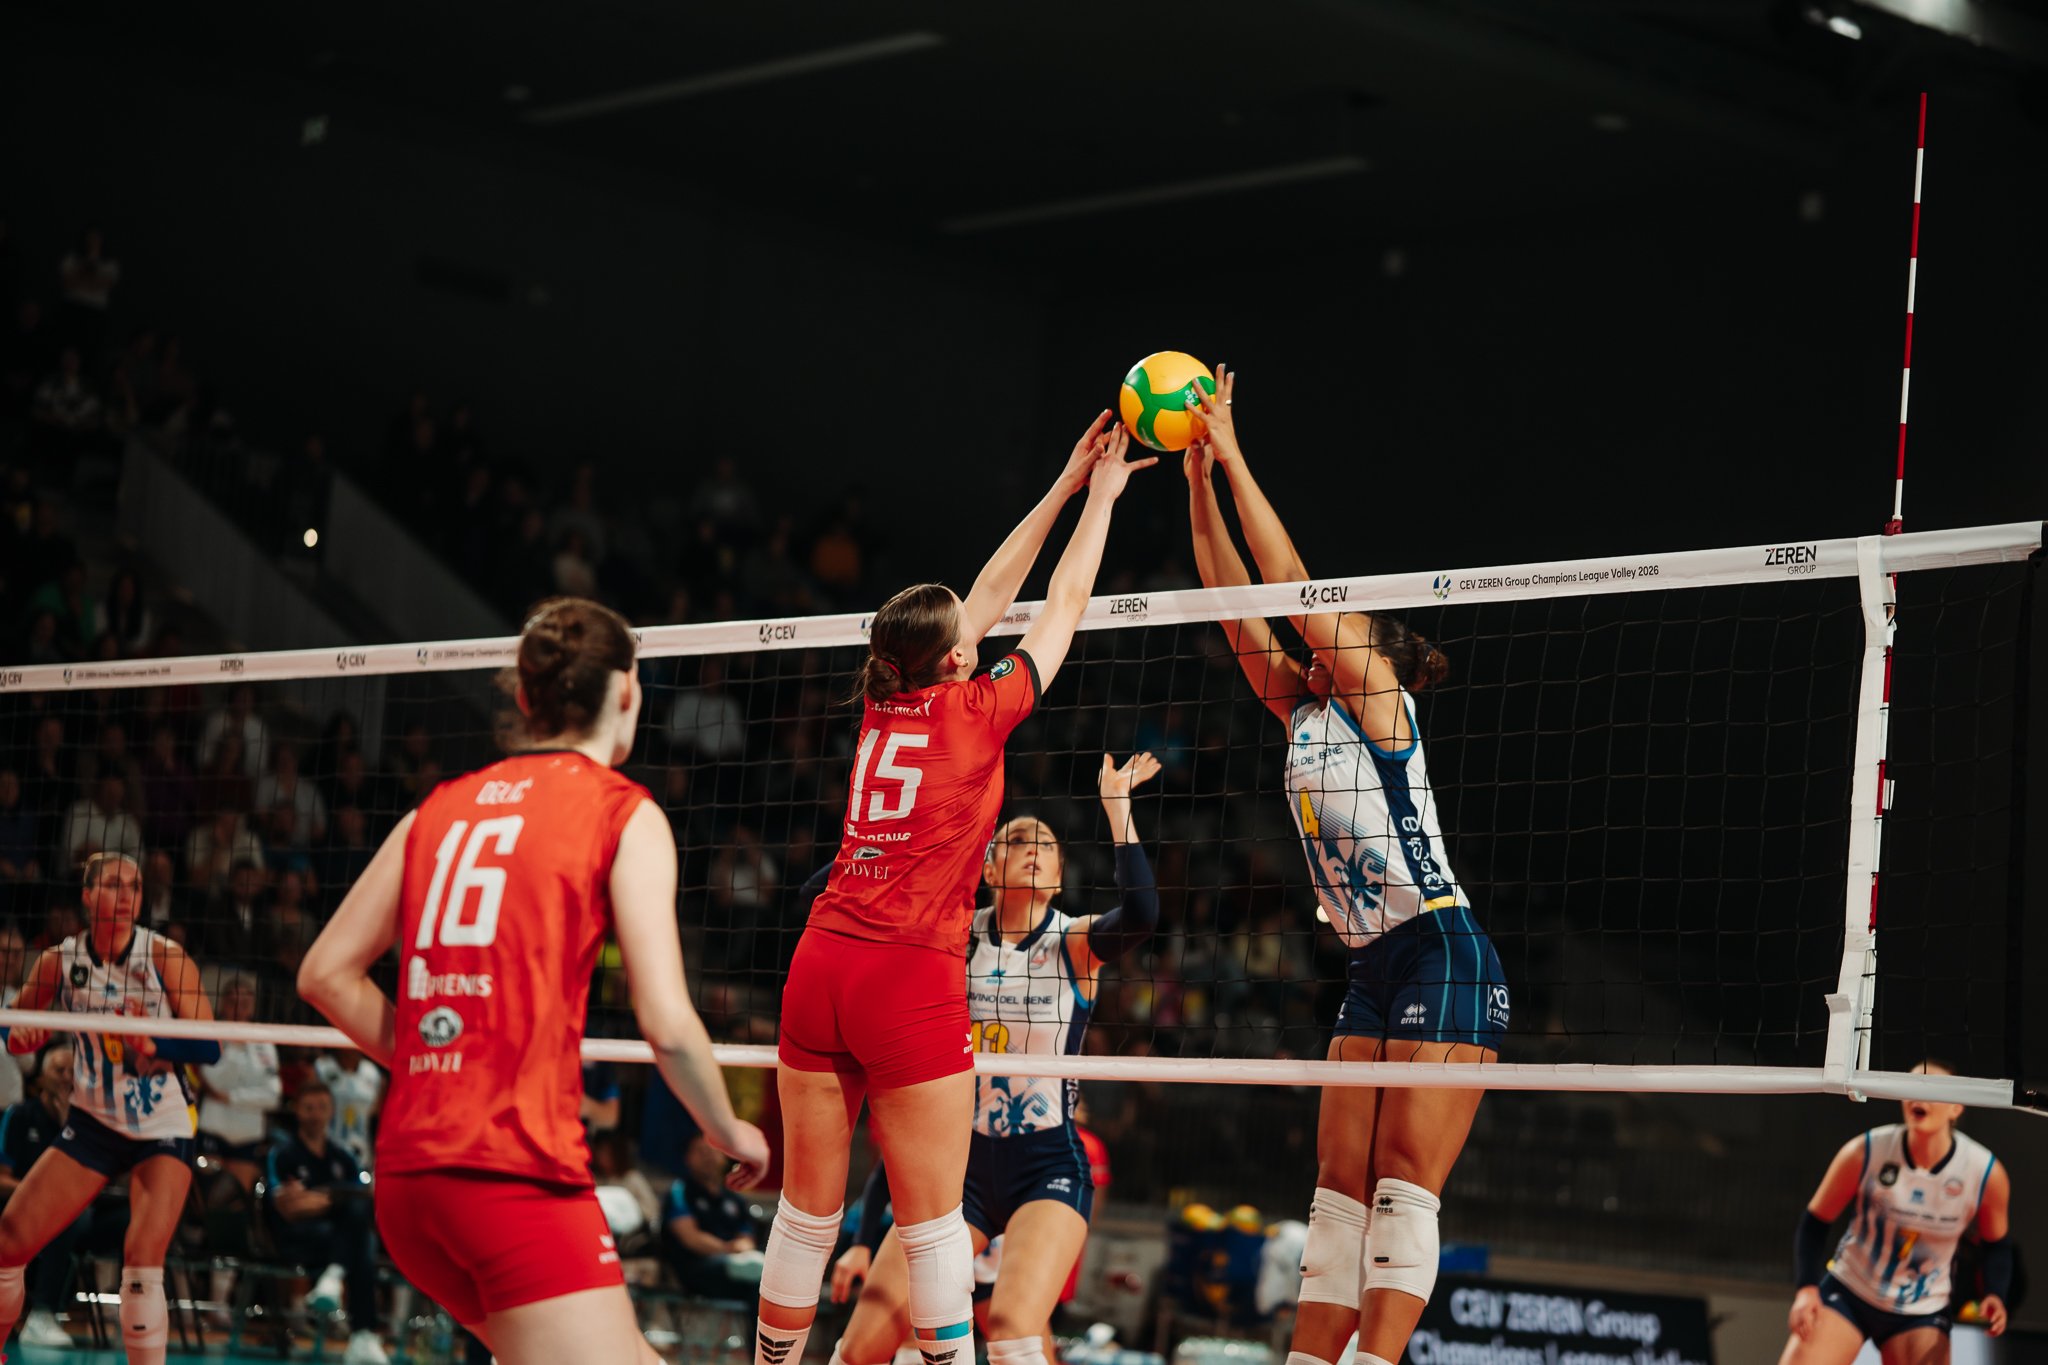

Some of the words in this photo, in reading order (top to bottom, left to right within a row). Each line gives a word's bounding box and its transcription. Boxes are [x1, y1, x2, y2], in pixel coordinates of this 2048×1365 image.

[1765, 545, 1817, 566] ZEREN
[1460, 580, 1476, 590] CEV
[1478, 577, 1503, 589] ZEREN
[1505, 576, 1531, 588] Group
[1532, 573, 1577, 586] Champions
[1579, 569, 1609, 583] League
[1610, 567, 1636, 580] Volley
[1638, 565, 1659, 576] 2026
[1787, 564, 1817, 575] GROUP
[1321, 586, 1348, 603] CEV
[1110, 597, 1149, 615] ZEREN
[1014, 611, 1031, 623] 2026
[774, 625, 796, 640] CEV
[349, 653, 366, 667] CEV
[850, 728, 929, 822] 15
[415, 814, 525, 950] 16
[999, 994, 1019, 1005] DEL
[1023, 995, 1053, 1006] BENE
[1899, 1229, 1920, 1260] 7
[1450, 1287, 1504, 1329] CEV
[1505, 1292, 1583, 1336] ZEREN
[1584, 1299, 1661, 1345] Group
